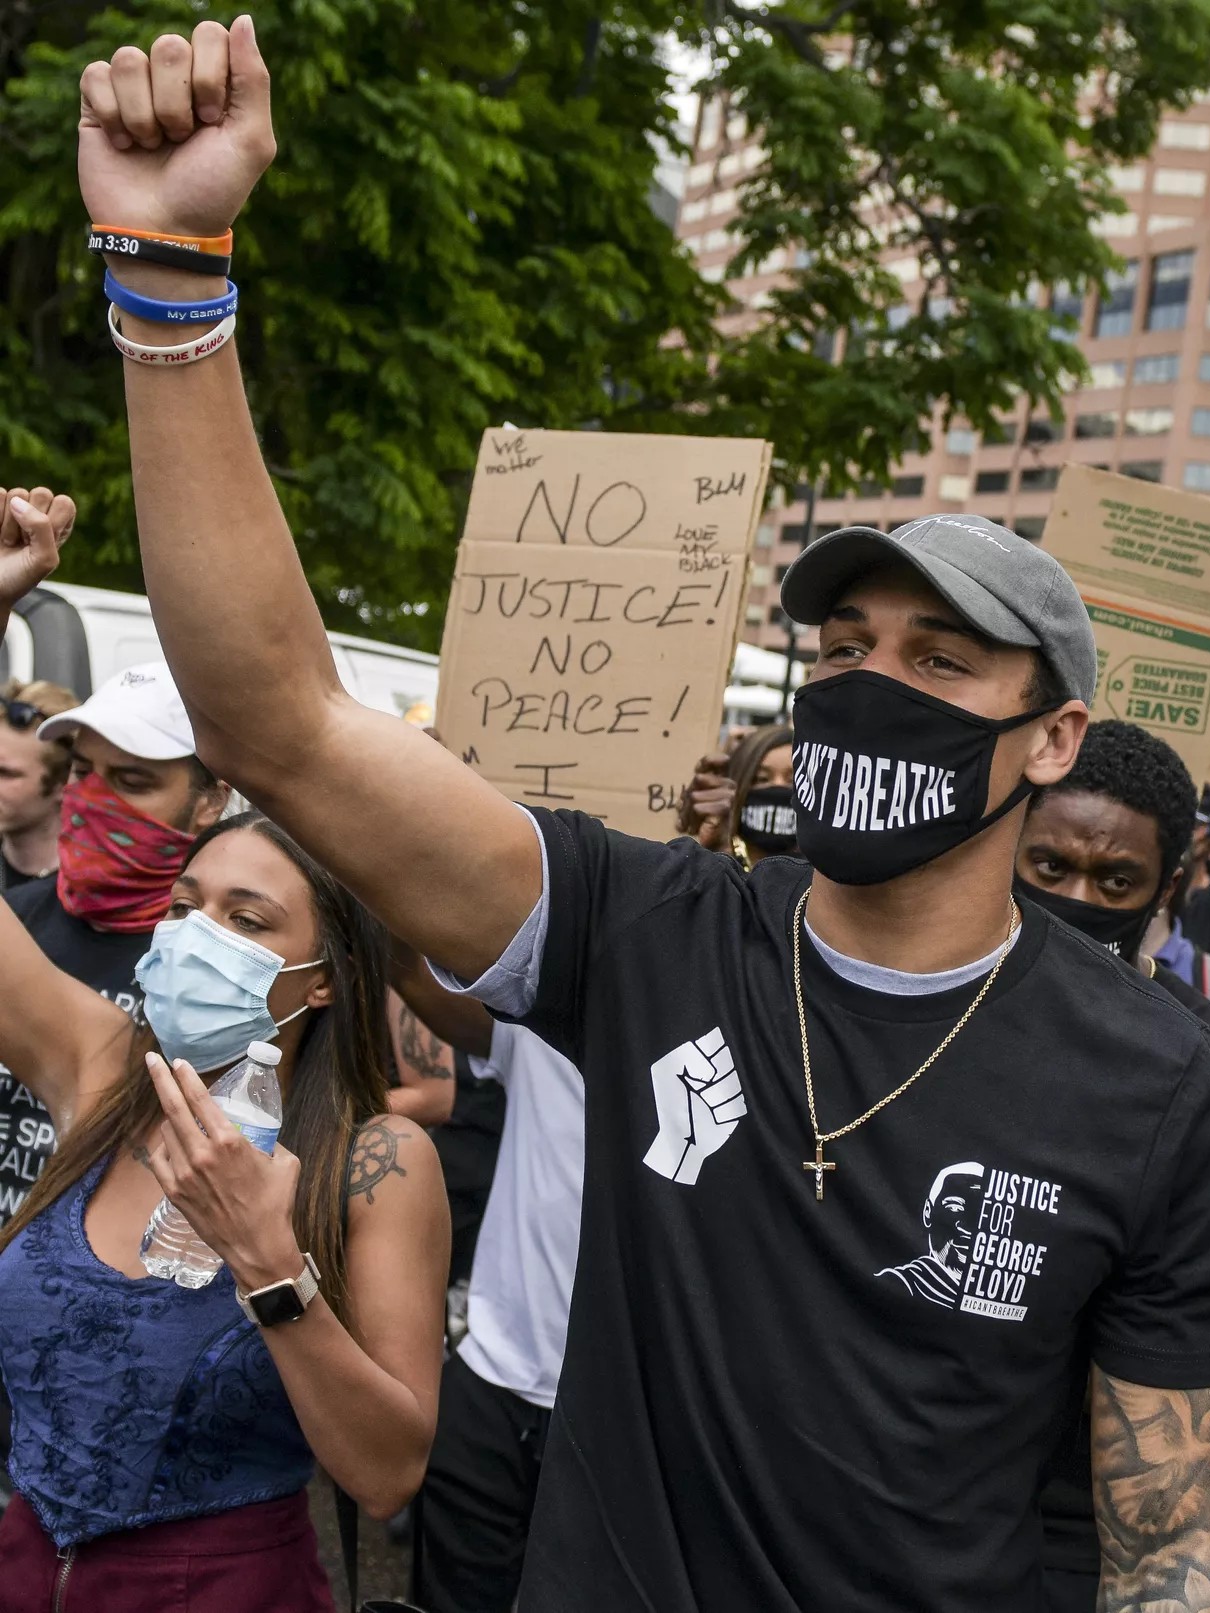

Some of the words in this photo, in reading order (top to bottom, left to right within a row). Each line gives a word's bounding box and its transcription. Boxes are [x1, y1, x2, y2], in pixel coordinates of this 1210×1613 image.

[88, 233, 103, 249] hn
[105, 235, 140, 255] 3:30
[167, 310, 187, 320] My
[190, 307, 225, 318] Game.
[140, 352, 158, 362] OF
[162, 351, 189, 362] THE
[694, 472, 746, 504] BLM
[517, 473, 646, 547] NO
[679, 555, 733, 573] BLACK
[460, 571, 728, 627] JUSTICE!
[530, 635, 611, 674] NO
[471, 677, 689, 738] PEACE!
[1125, 699, 1201, 726] SAVE!
[648, 784, 692, 813] BL
[832, 751, 956, 831] BREATHE
[984, 1169, 1062, 1214] JUSTICE
[978, 1200, 1015, 1236] FOR
[972, 1232, 1047, 1276] GEORGE
[964, 1263, 1026, 1303] FLOYD
[962, 1298, 1025, 1318] #ICANTBREATHE
